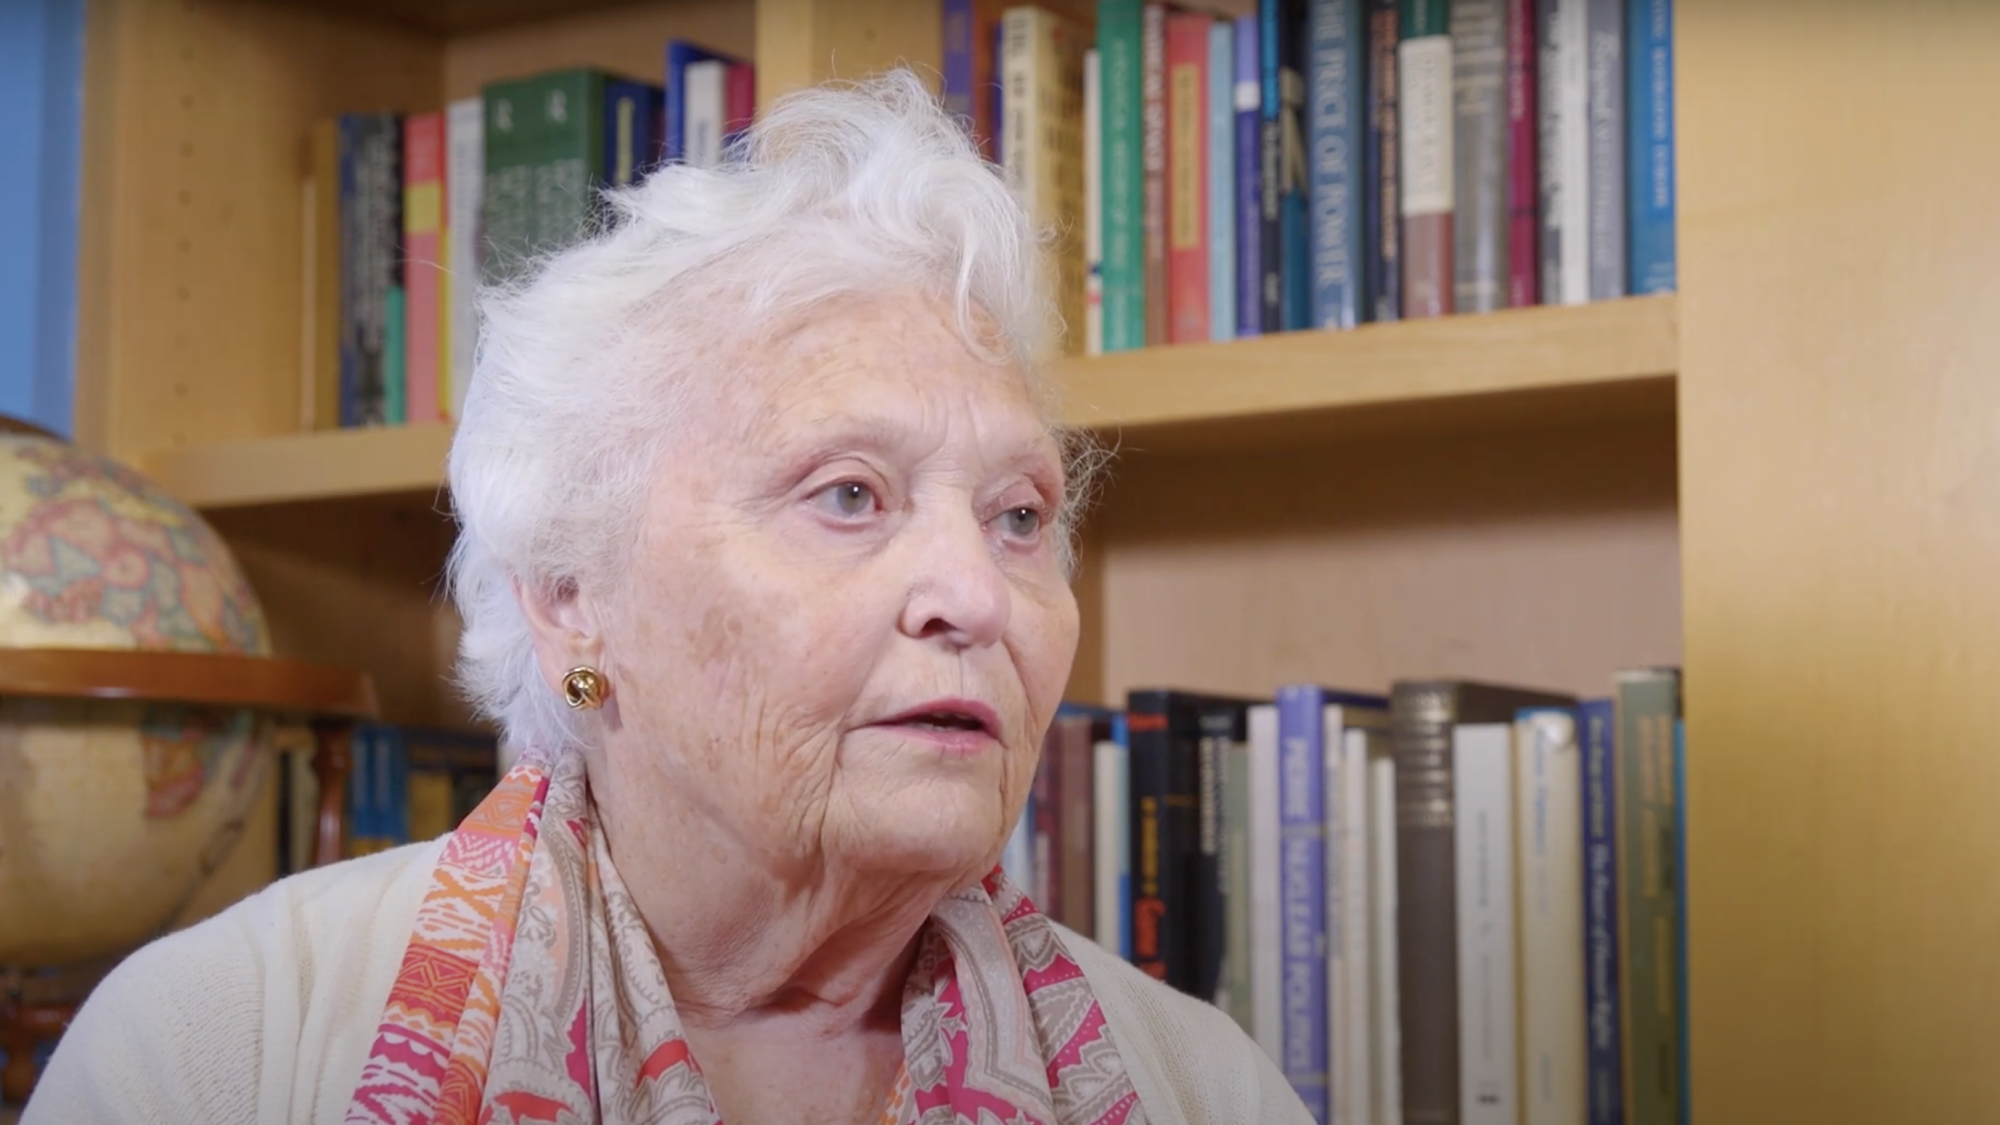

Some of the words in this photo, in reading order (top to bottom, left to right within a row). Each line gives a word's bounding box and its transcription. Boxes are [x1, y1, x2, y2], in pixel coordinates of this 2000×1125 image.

[1315, 0, 1346, 42] HE
[1316, 49, 1346, 127] PRICE
[1317, 135, 1346, 176] OF
[1316, 184, 1346, 288] POWER
[1284, 838, 1312, 957] NUCLEAR
[1286, 961, 1313, 1072] POLITICS
